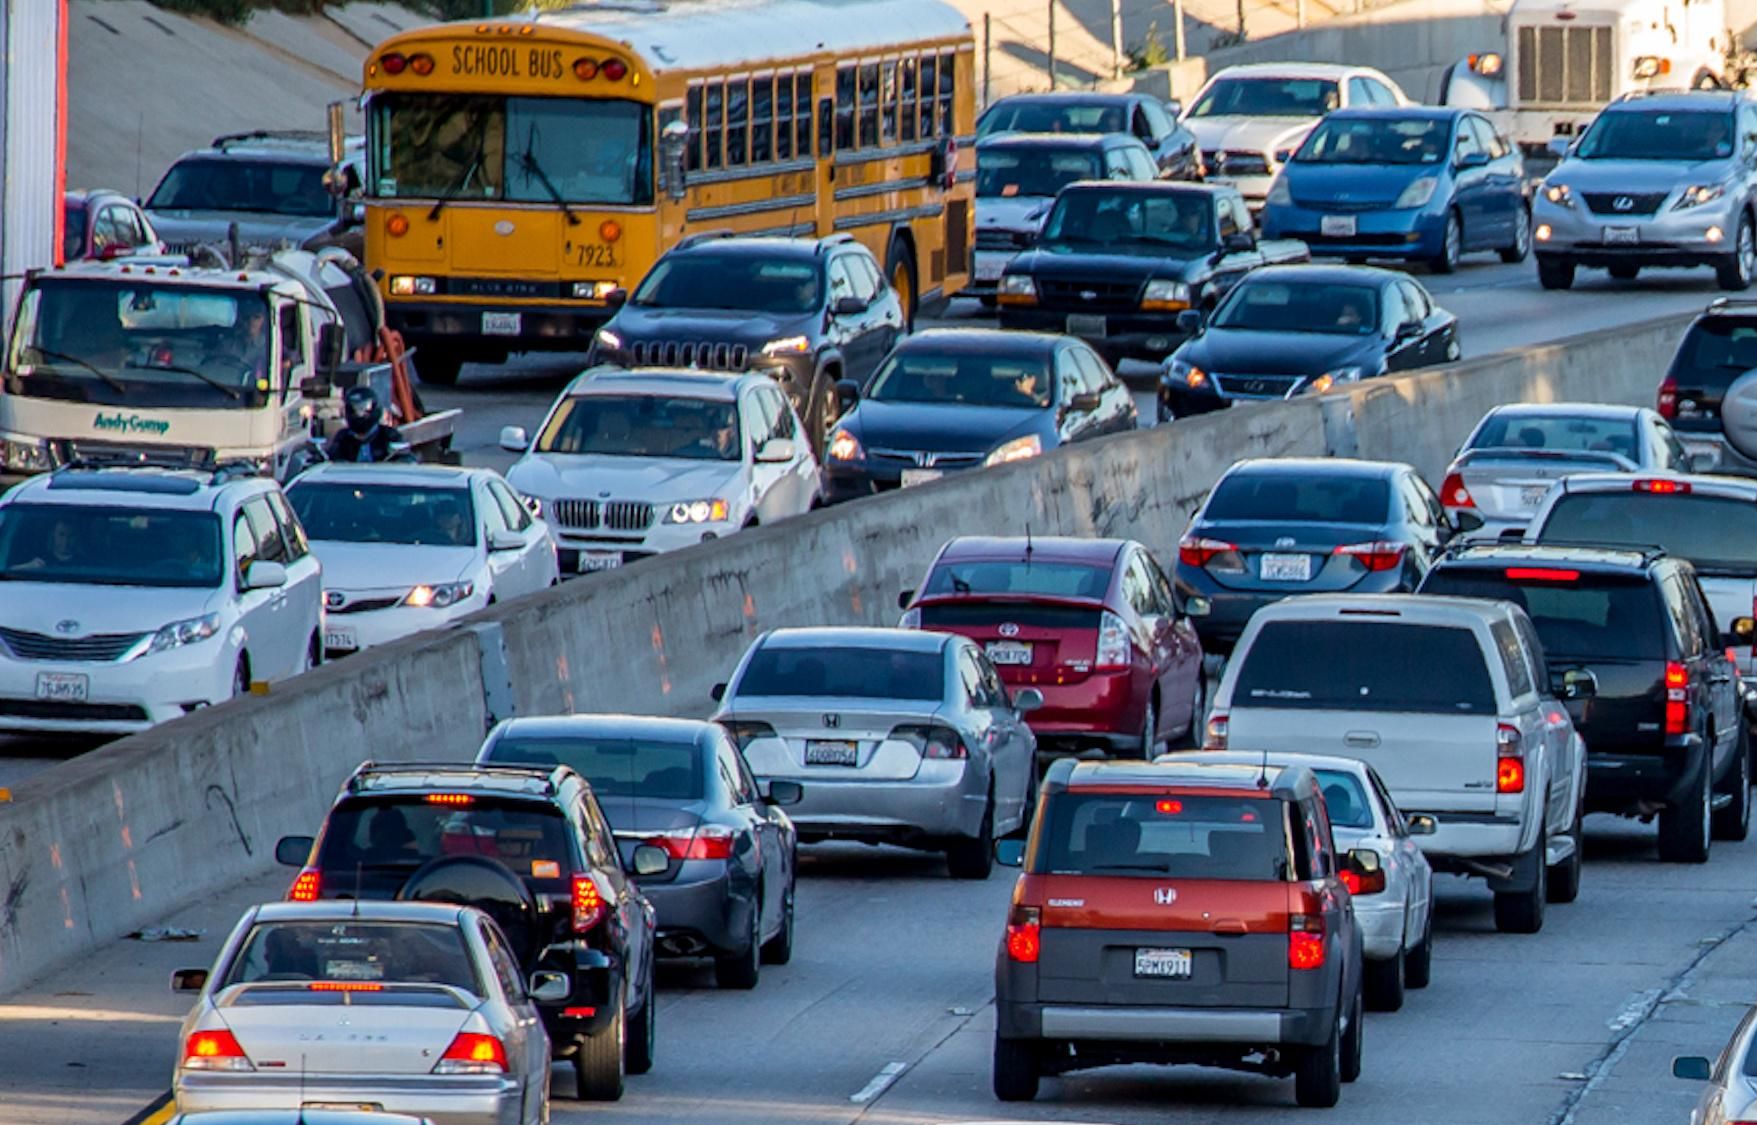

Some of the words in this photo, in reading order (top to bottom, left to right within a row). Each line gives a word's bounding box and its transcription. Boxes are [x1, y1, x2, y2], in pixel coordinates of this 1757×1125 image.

[452, 45, 520, 77] SCHOOL
[529, 48, 564, 80] BUS
[576, 244, 617, 267] 7923
